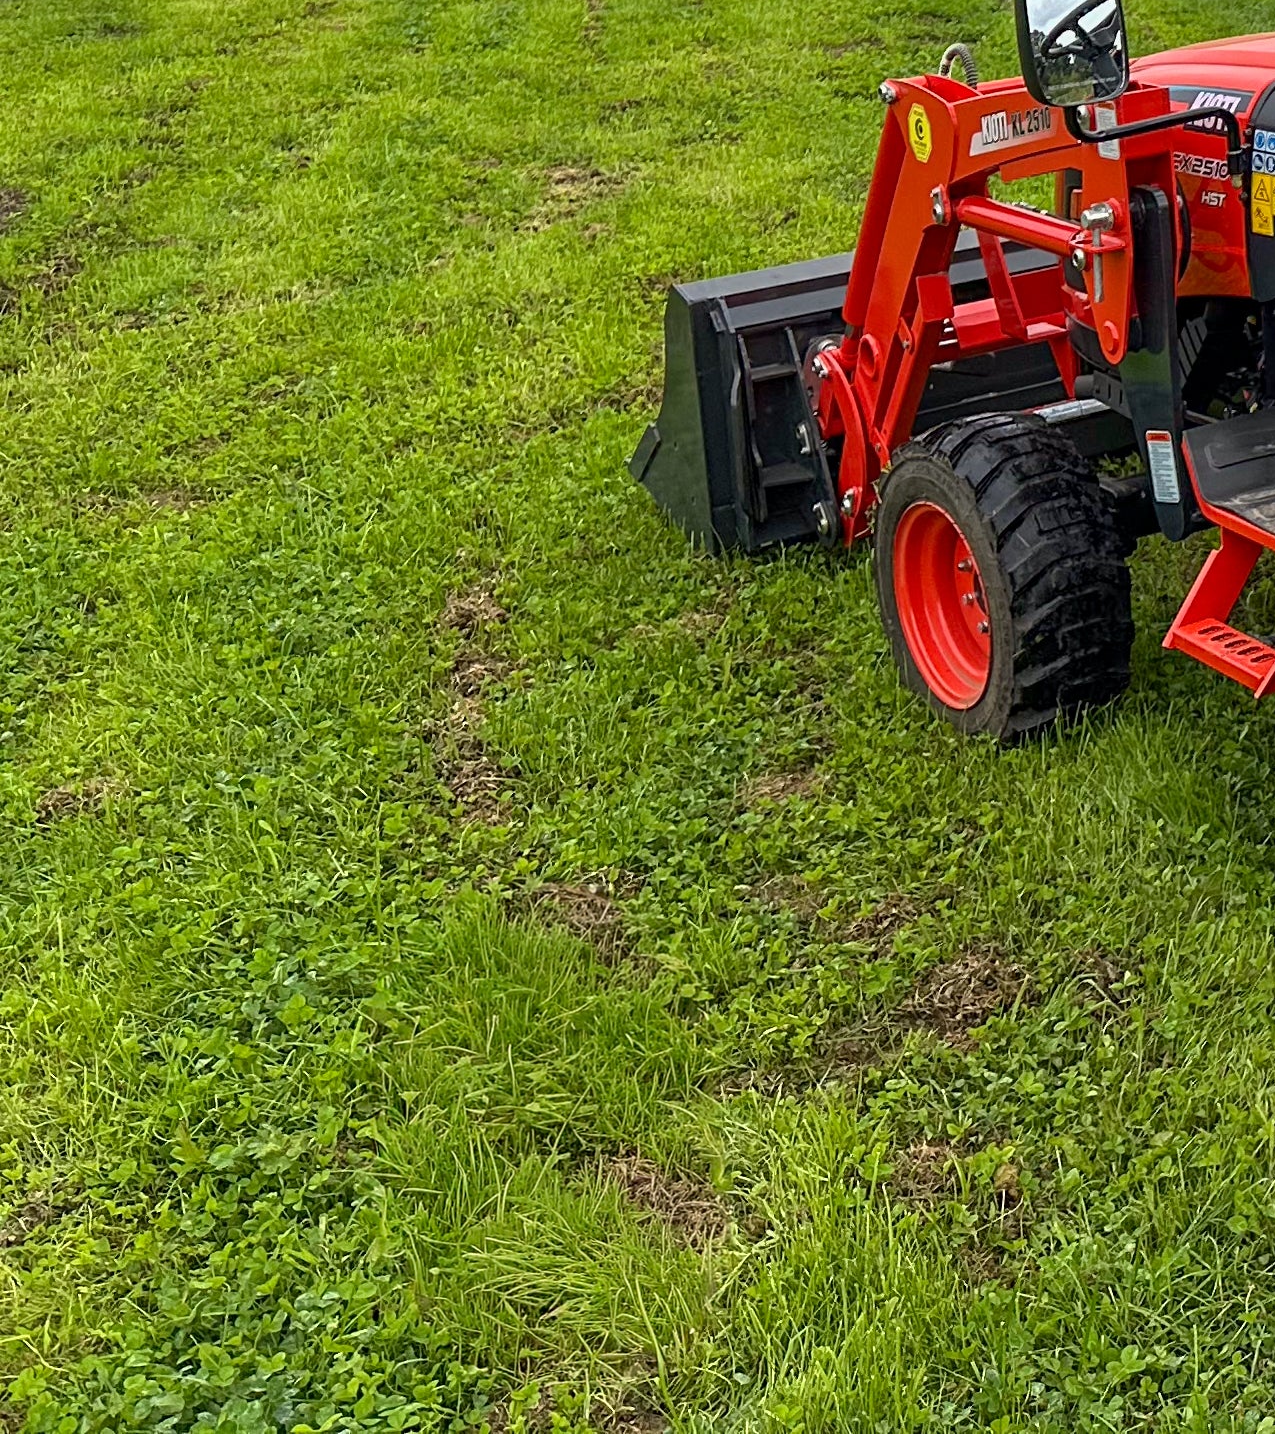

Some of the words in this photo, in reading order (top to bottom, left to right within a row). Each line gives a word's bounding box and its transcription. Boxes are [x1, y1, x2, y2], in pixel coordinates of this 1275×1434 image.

[981, 110, 1009, 145] KIOTI
[1011, 115, 1025, 138] KL
[1026, 107, 1051, 133] 2510
[1201, 191, 1227, 206] HST
